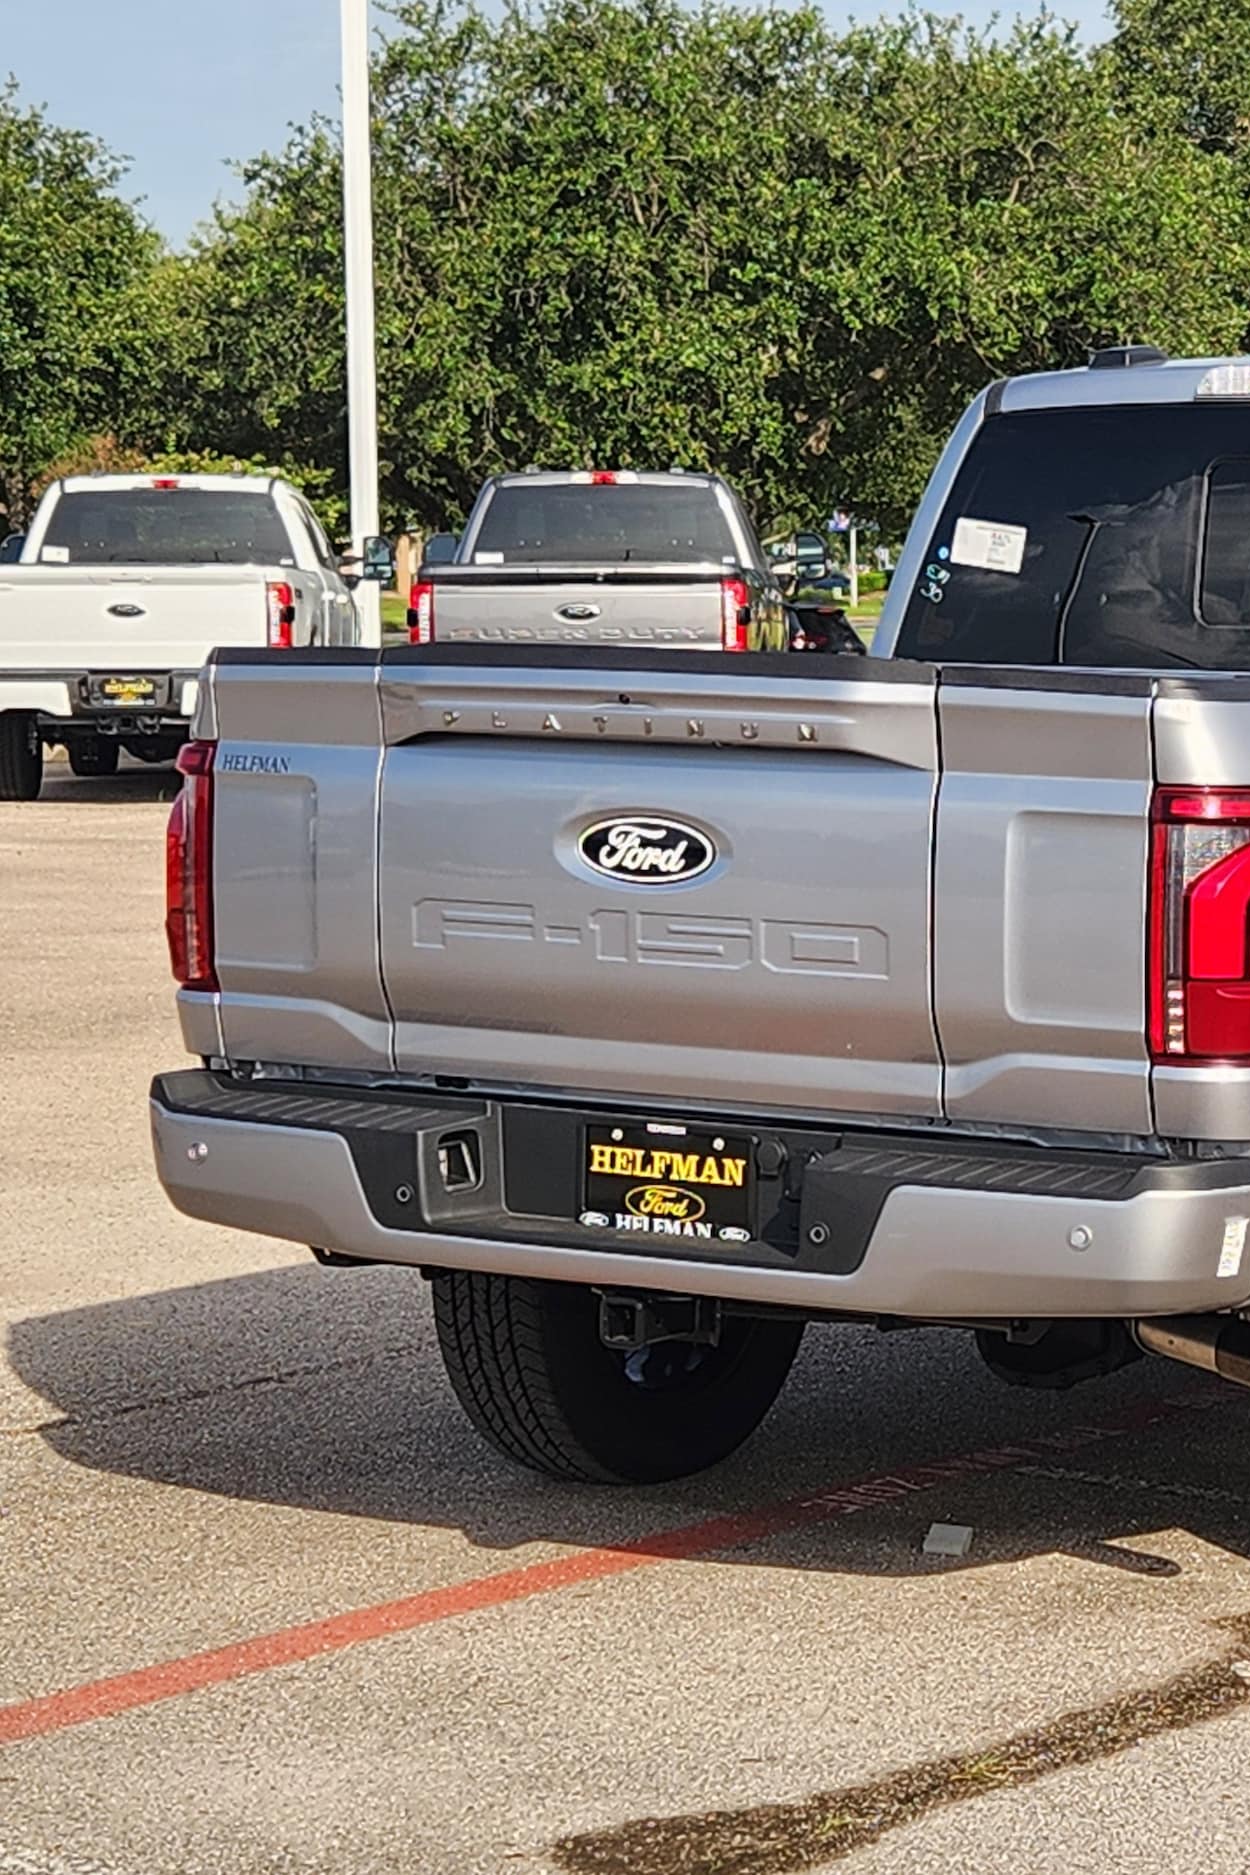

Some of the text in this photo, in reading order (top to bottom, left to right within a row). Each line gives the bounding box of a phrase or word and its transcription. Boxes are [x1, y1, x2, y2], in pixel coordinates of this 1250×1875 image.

[600, 626, 705, 641] DUTY
[442, 709, 819, 743] PLATINUM
[222, 753, 291, 774] HELFMAN
[598, 824, 689, 873] Ford
[412, 896, 889, 981] F-150
[589, 1144, 747, 1187] HELFMAN
[640, 1188, 689, 1217] Ford
